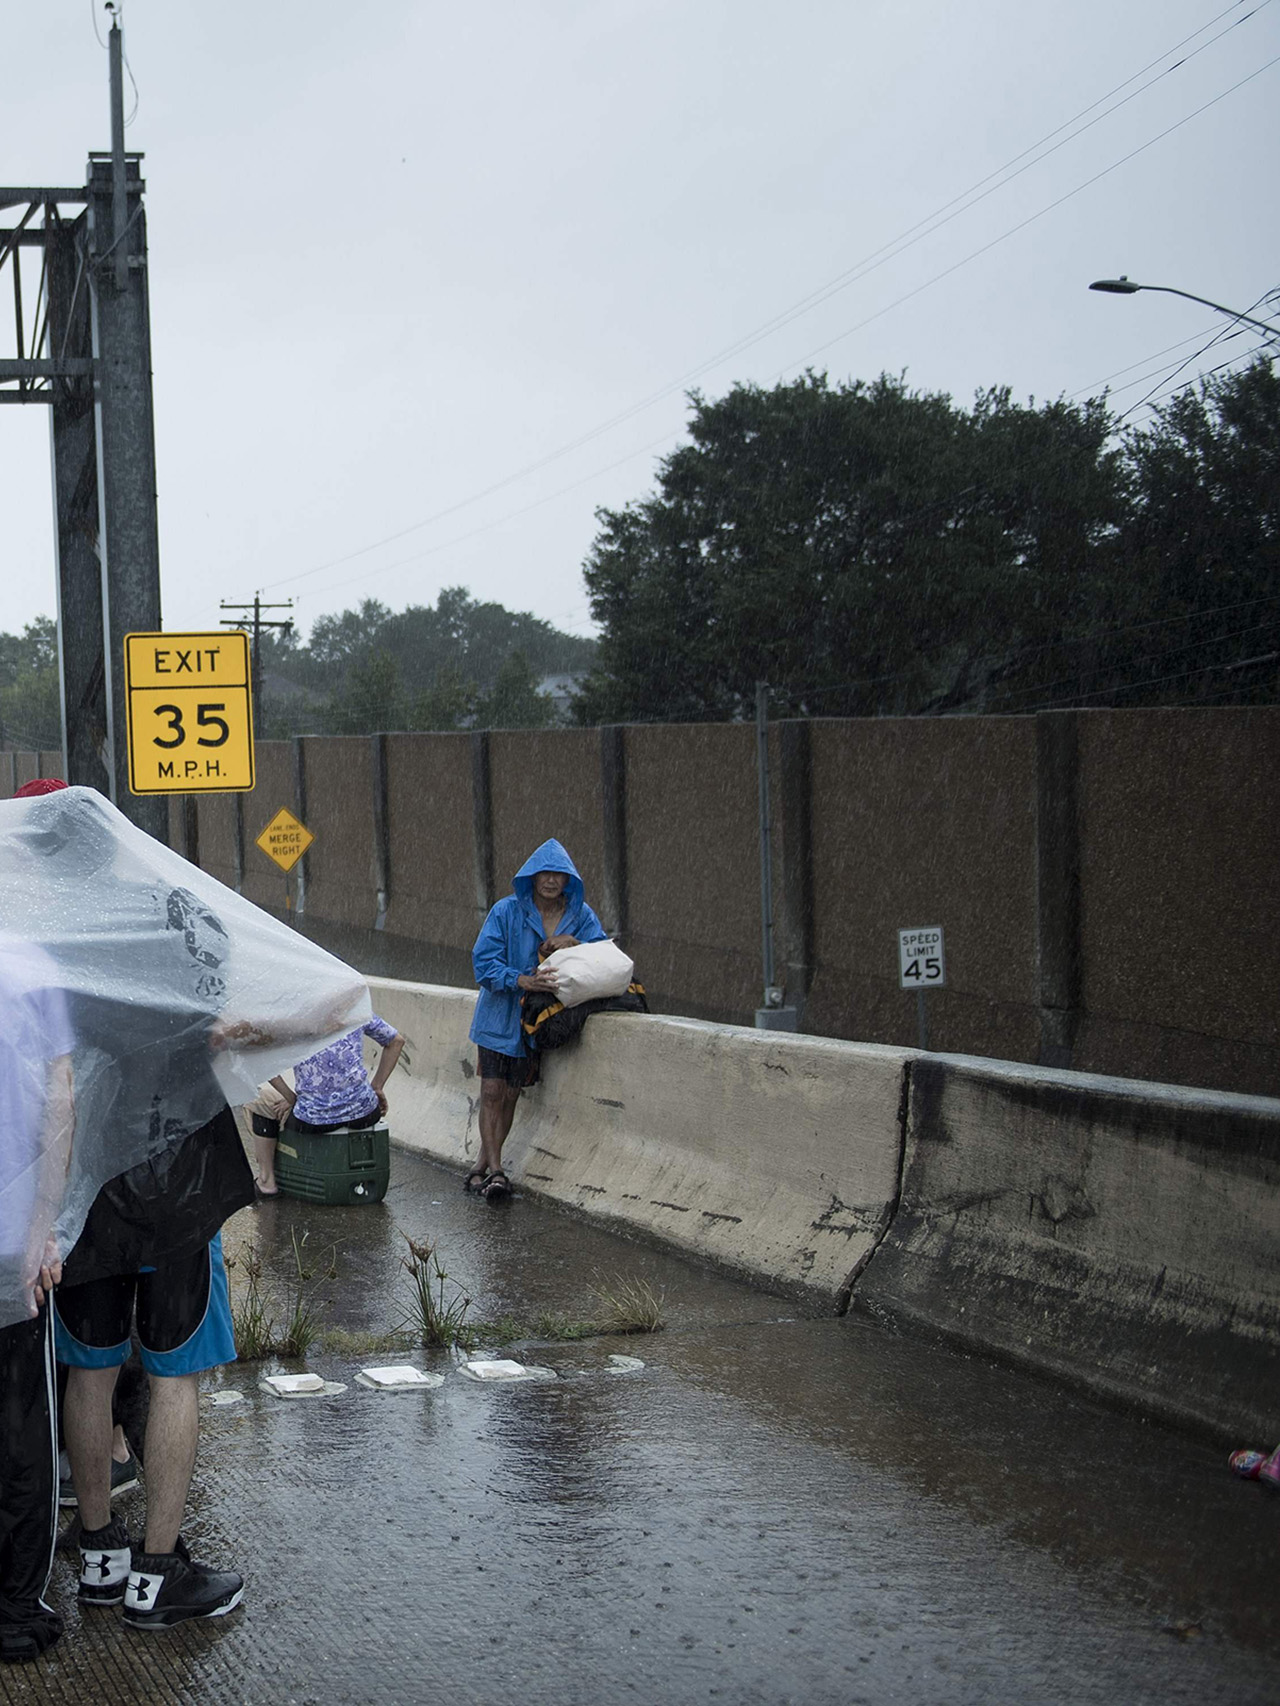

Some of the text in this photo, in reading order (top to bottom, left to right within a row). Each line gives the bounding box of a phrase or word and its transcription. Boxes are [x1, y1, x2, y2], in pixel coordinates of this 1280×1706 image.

[155, 649, 221, 673] EXIT
[152, 703, 230, 749] 35
[158, 759, 227, 779] M.P.H.
[269, 832, 301, 844] MERGE
[272, 845, 301, 856] RIGHT
[902, 933, 940, 946] SPEED
[906, 946, 936, 957] LIMIT
[904, 958, 941, 981] 45
